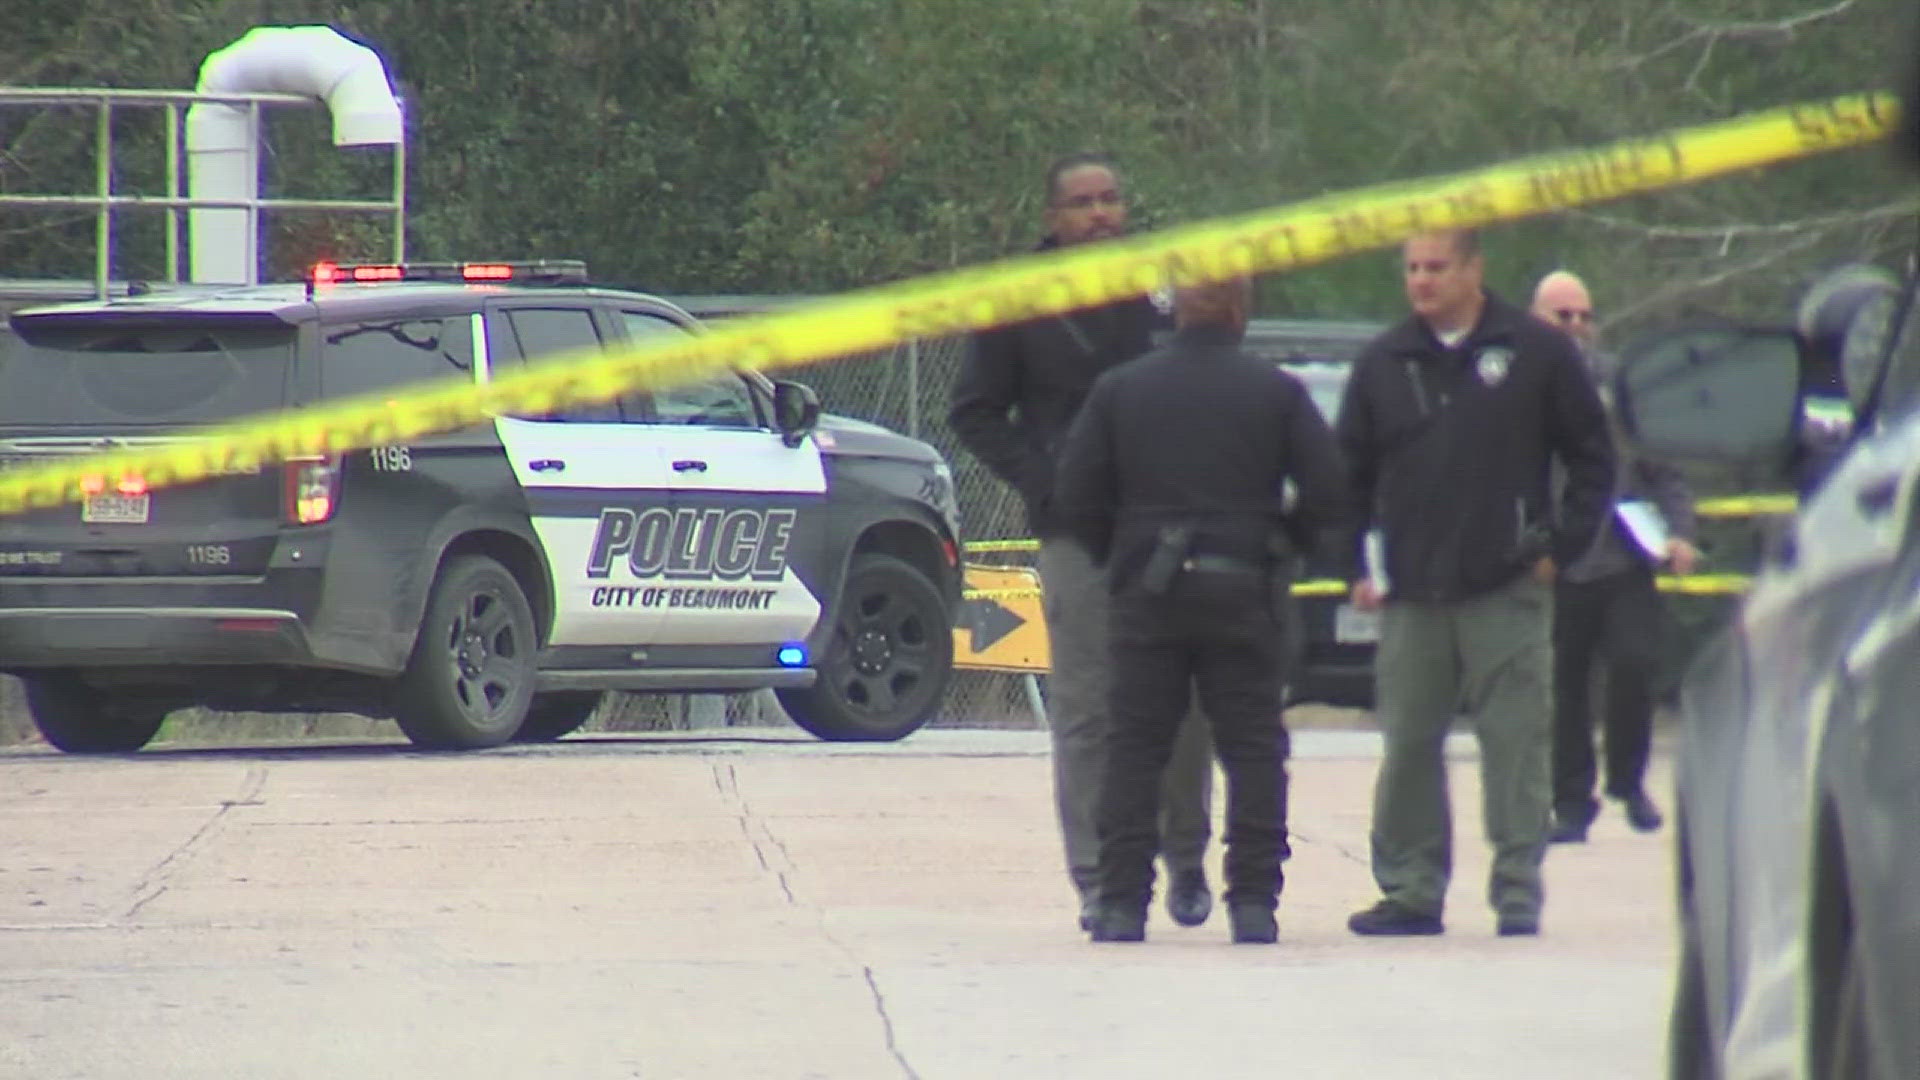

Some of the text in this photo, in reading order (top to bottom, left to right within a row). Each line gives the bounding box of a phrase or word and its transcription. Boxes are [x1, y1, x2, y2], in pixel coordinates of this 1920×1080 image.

[370, 446, 412, 471] 1196
[187, 545, 230, 565] 1196
[587, 507, 797, 582] POLICE
[592, 586, 776, 609] CITY OF BEAUMONT
